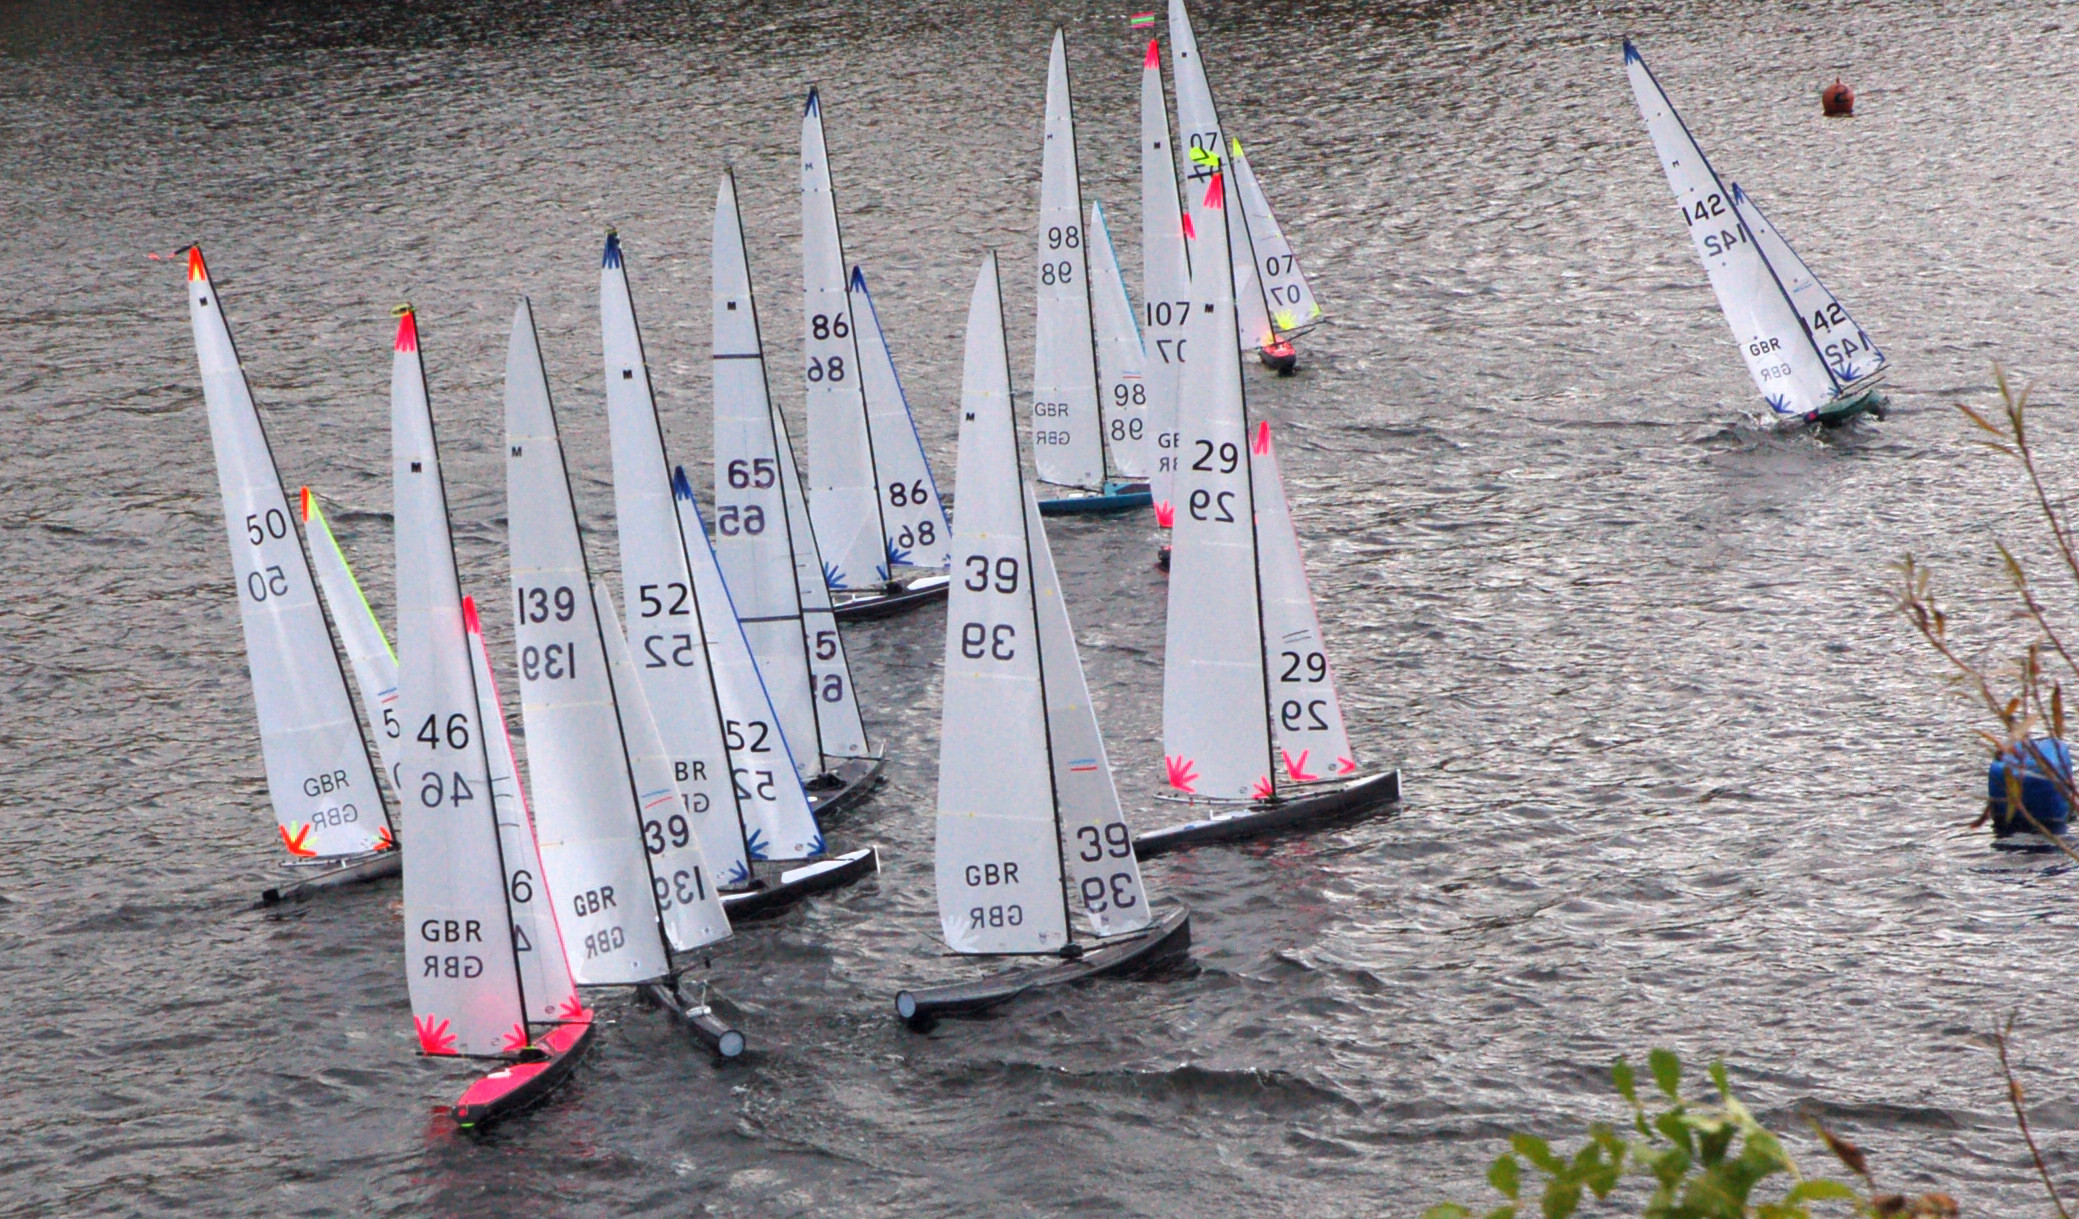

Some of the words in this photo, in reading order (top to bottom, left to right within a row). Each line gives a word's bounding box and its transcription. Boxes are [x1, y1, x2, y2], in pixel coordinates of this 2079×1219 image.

[805, 162, 814, 171] M
[1682, 193, 1725, 227] 142
[1048, 226, 1080, 249] 98
[1267, 254, 1294, 277] 07
[1147, 302, 1190, 327] 107
[1204, 303, 1214, 313] M
[1802, 303, 1846, 336] 142
[812, 312, 849, 340] 86
[1749, 336, 1781, 357] GBR
[622, 369, 632, 380] M
[1034, 402, 1068, 417] GBR
[1114, 383, 1146, 407] 98
[966, 412, 975, 422] M
[512, 446, 522, 457] M
[1192, 439, 1238, 474] 29
[411, 462, 422, 473] M
[727, 457, 776, 490] 65
[890, 479, 928, 508] 86
[246, 508, 287, 546] 50
[964, 554, 1018, 595] 39
[518, 586, 575, 625] 139
[640, 582, 690, 618] 52
[807, 631, 837, 660] 5
[1280, 650, 1326, 684] 29
[383, 708, 400, 739] 5
[416, 713, 470, 750] 46
[726, 720, 772, 753] 52
[304, 769, 350, 798] GBR
[674, 760, 707, 782] BR
[645, 814, 689, 855] 39
[1076, 821, 1131, 863] 39
[511, 869, 533, 903] 6
[965, 861, 1020, 888] GBR
[574, 885, 617, 919] GBR
[420, 919, 482, 944] GBR
